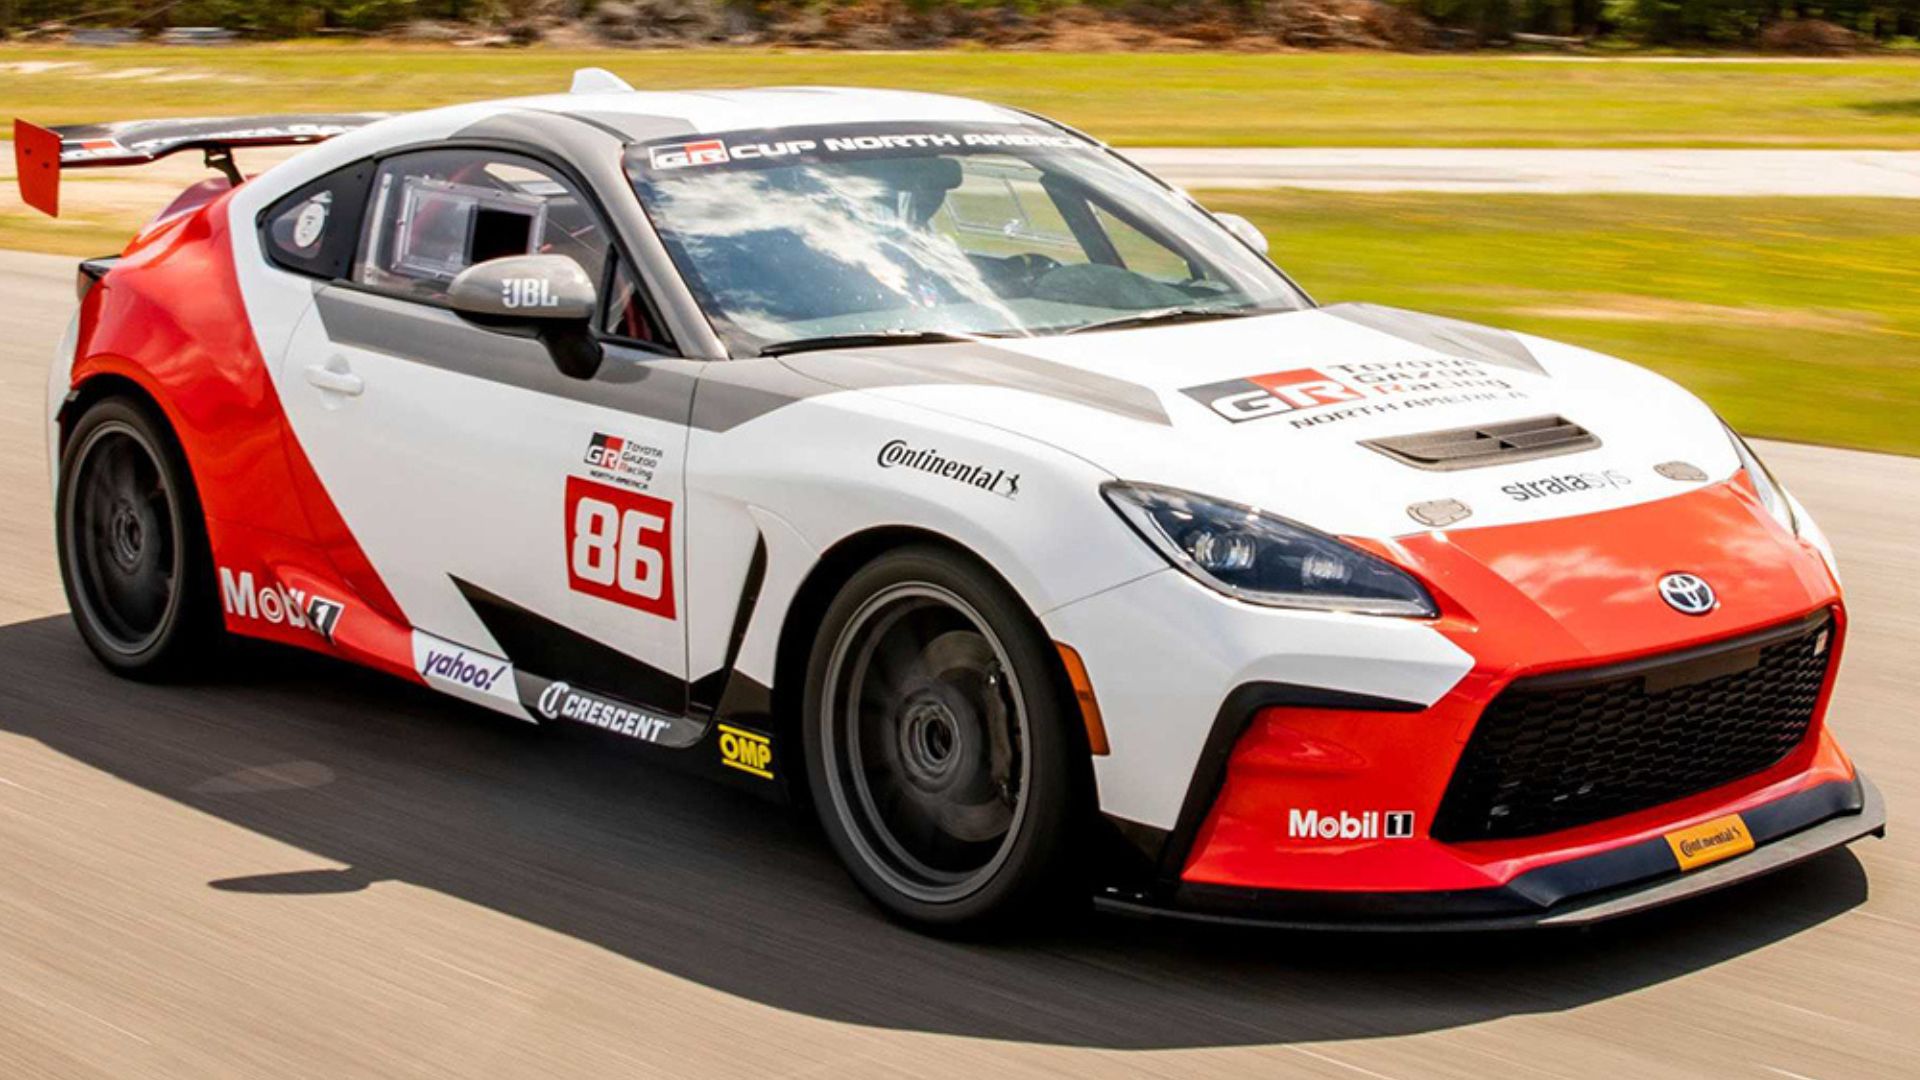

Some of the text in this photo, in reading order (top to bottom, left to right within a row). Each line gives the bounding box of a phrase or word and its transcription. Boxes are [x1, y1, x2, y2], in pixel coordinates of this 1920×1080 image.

[654, 148, 727, 169] GR
[729, 140, 817, 160] CUP
[822, 134, 961, 152] NORTH
[502, 278, 559, 308] JBL
[1210, 380, 1362, 422] GR
[1289, 404, 1399, 429] NORTH
[586, 445, 618, 469] GR
[621, 451, 657, 468] GAZOO
[627, 440, 663, 458] TOYOTA
[877, 439, 1006, 492] Continental
[617, 462, 653, 481] Racing
[572, 497, 665, 600] 86
[423, 651, 507, 690] yahoo!
[561, 694, 667, 743] CRESCENT
[720, 733, 772, 769] OMP
[1288, 808, 1379, 839] Mobil
